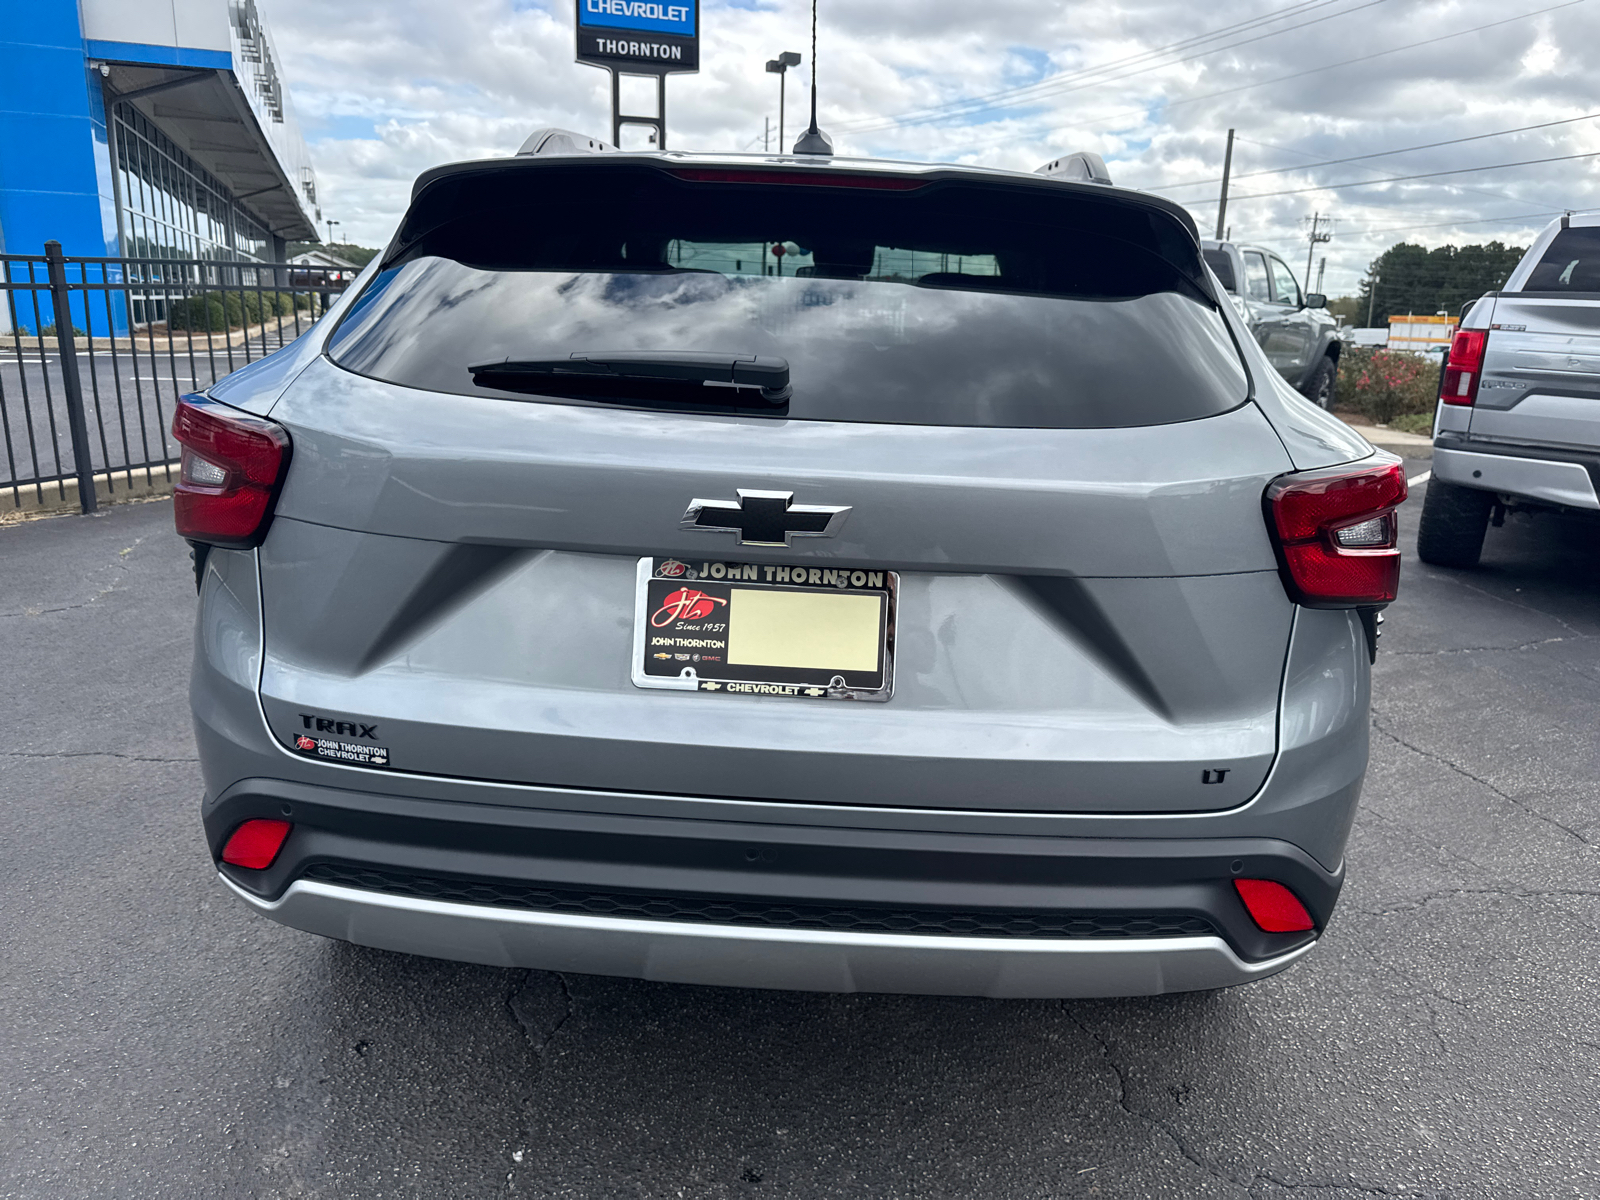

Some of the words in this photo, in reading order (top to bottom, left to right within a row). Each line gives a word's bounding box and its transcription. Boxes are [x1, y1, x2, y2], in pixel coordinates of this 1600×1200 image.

[587, 0, 689, 22] CHEVROLET
[596, 38, 681, 60] THORNTON
[699, 562, 758, 580] JOHN
[764, 566, 883, 587] THORNTON
[675, 621, 701, 631] Since
[702, 623, 726, 632] 1957
[651, 637, 675, 646] JOHN
[675, 638, 725, 649] THORNTON
[727, 682, 800, 695] CHEVROLET
[298, 713, 379, 740] TRAX
[317, 739, 339, 750] JOHN
[339, 742, 387, 757] THORNTON
[318, 748, 370, 762] CHEVROLET
[1202, 768, 1231, 784] LT
